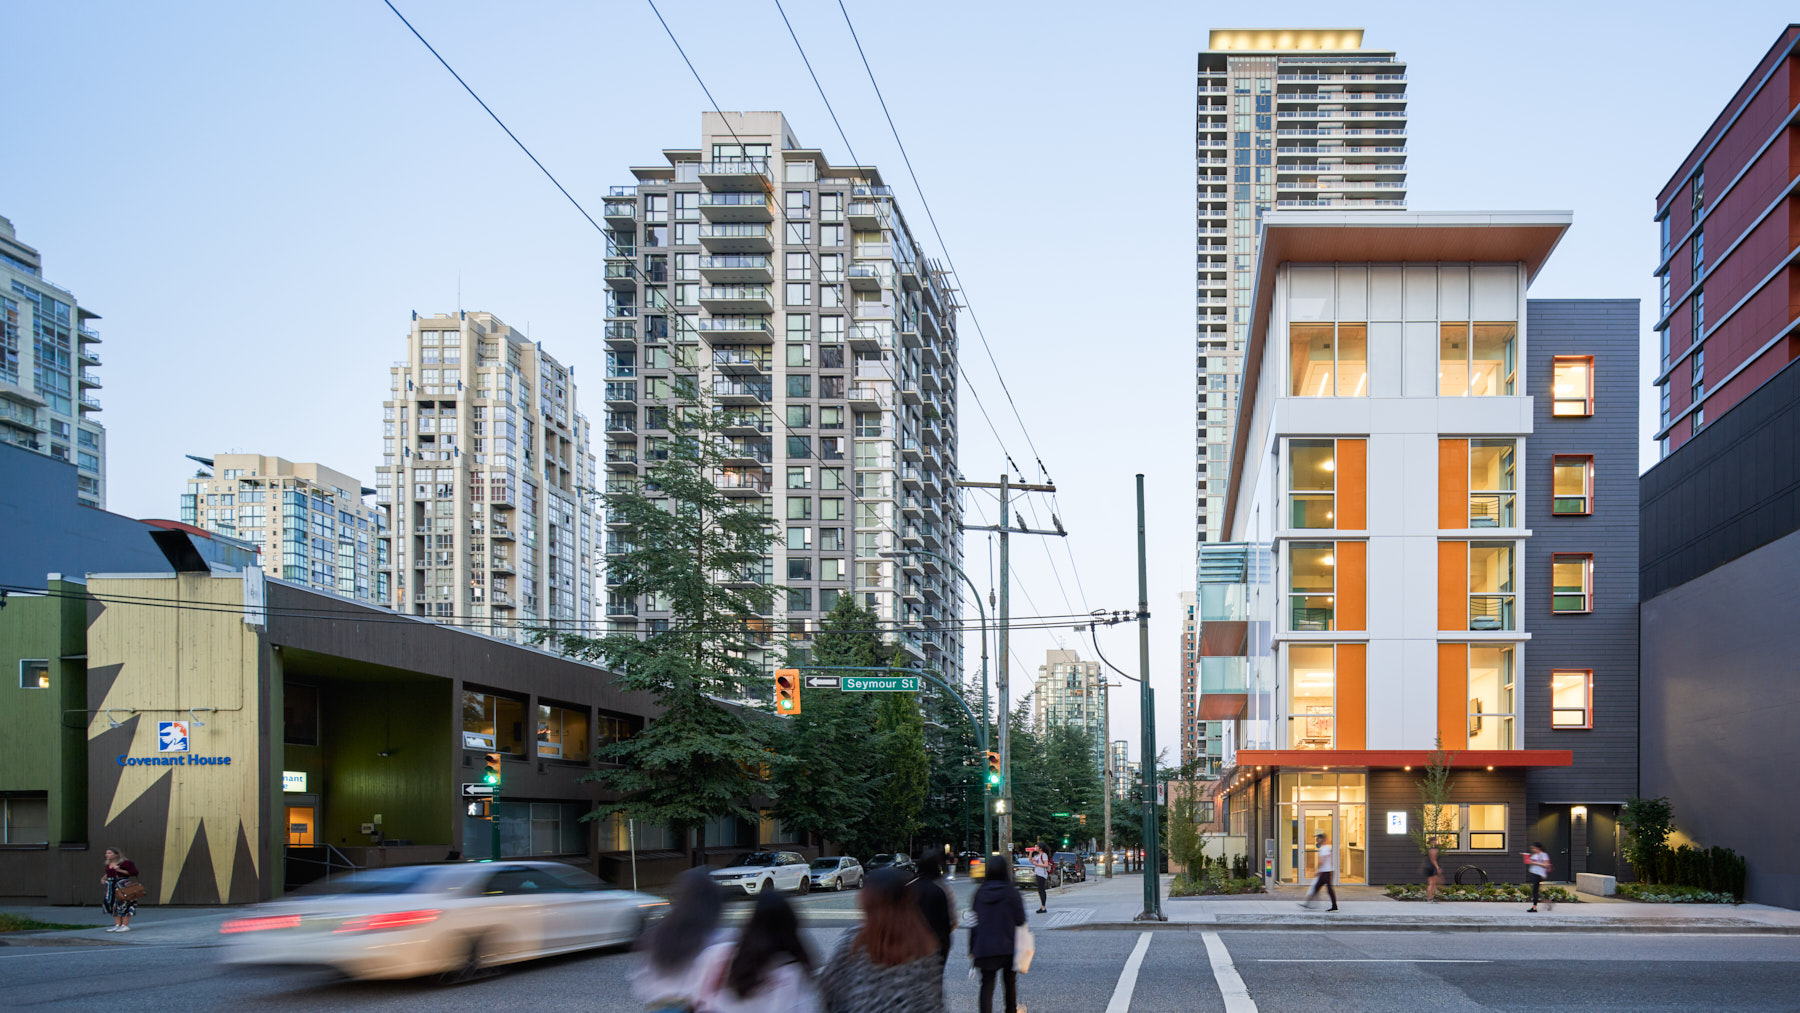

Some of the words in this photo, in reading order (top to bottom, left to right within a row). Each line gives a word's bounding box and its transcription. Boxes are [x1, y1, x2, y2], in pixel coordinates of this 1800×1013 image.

[847, 679, 896, 690] Seymour
[901, 679, 914, 688] St
[116, 754, 185, 766] Covenant
[187, 754, 231, 765] House
